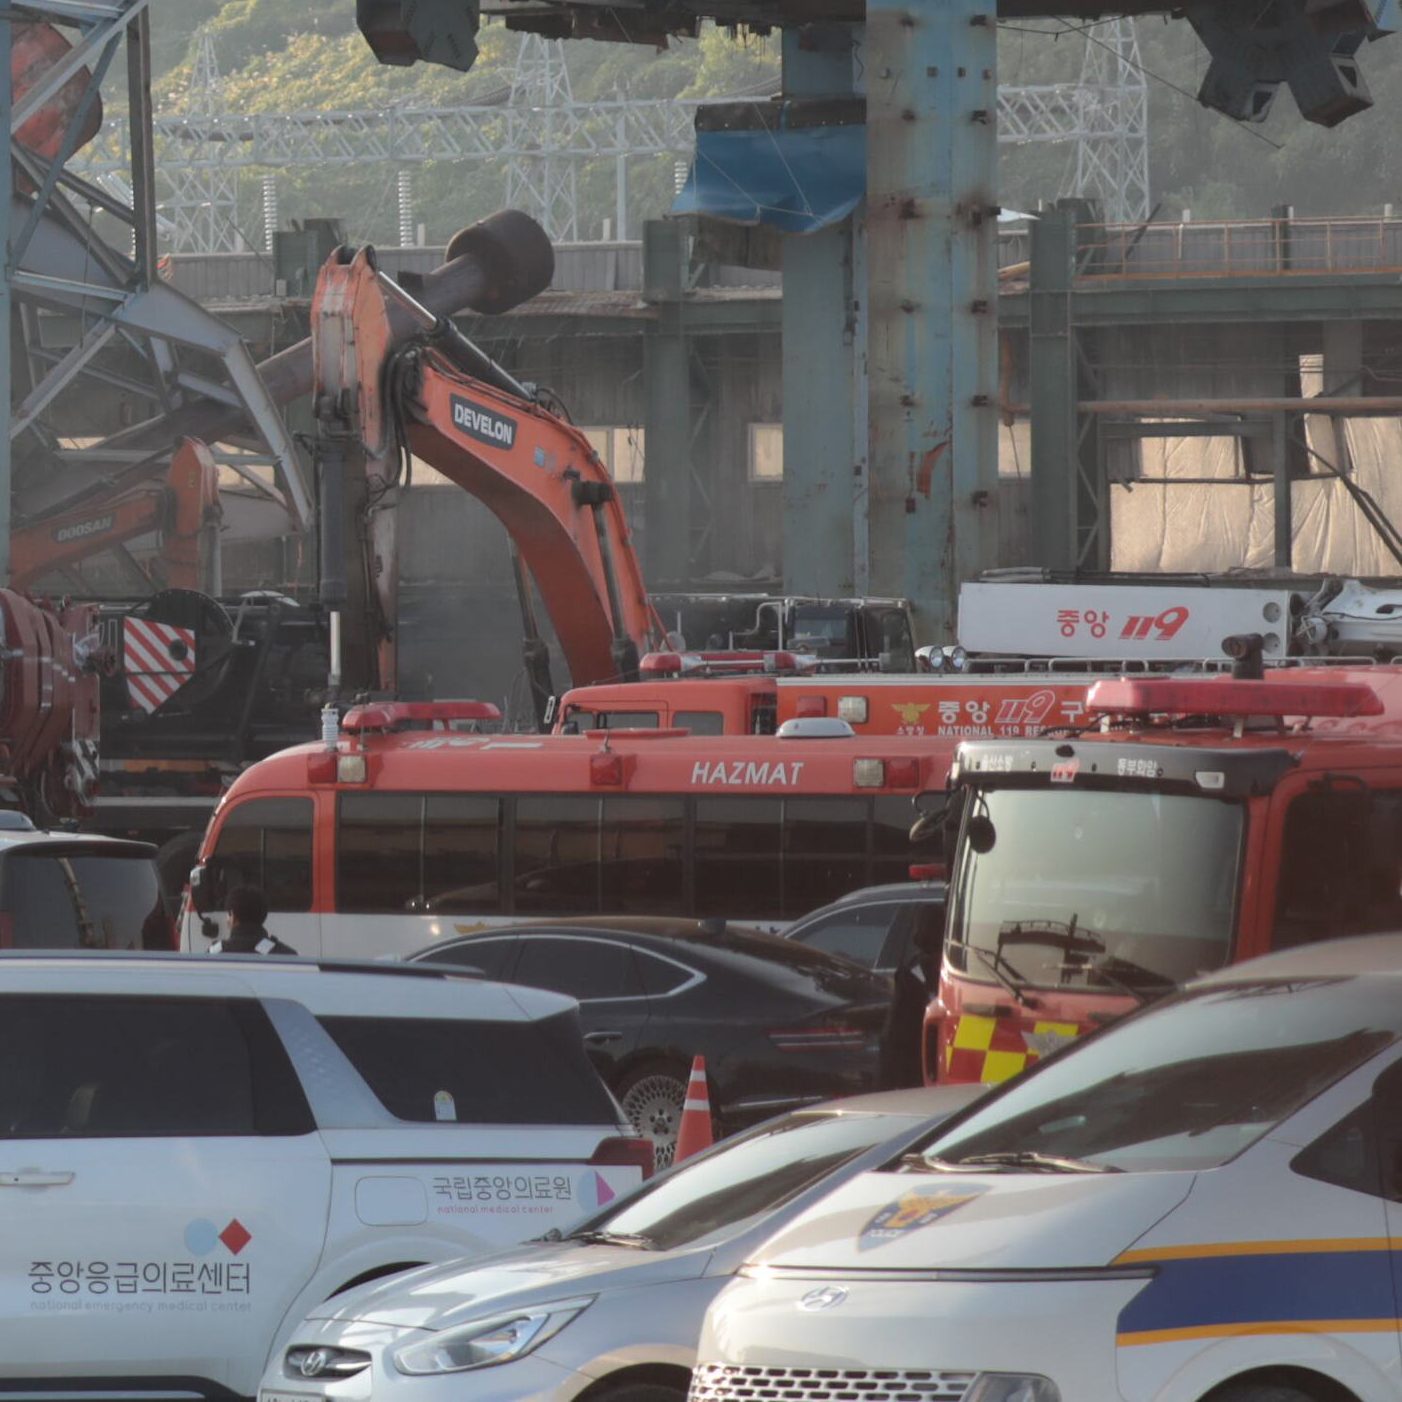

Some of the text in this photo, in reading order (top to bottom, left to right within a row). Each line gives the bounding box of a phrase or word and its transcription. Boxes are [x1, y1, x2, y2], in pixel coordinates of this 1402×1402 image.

[454, 403, 512, 445] DEVELON
[58, 515, 113, 542] DOOSAN
[1057, 606, 1190, 641] 중앙 119
[938, 725, 994, 737] NATIONAL
[691, 761, 805, 785] HAZMAT
[433, 1175, 572, 1201] 국립중앙의료원
[28, 1261, 250, 1295] 중앙응급의료센터
[30, 1300, 252, 1314] national emergency medical center
